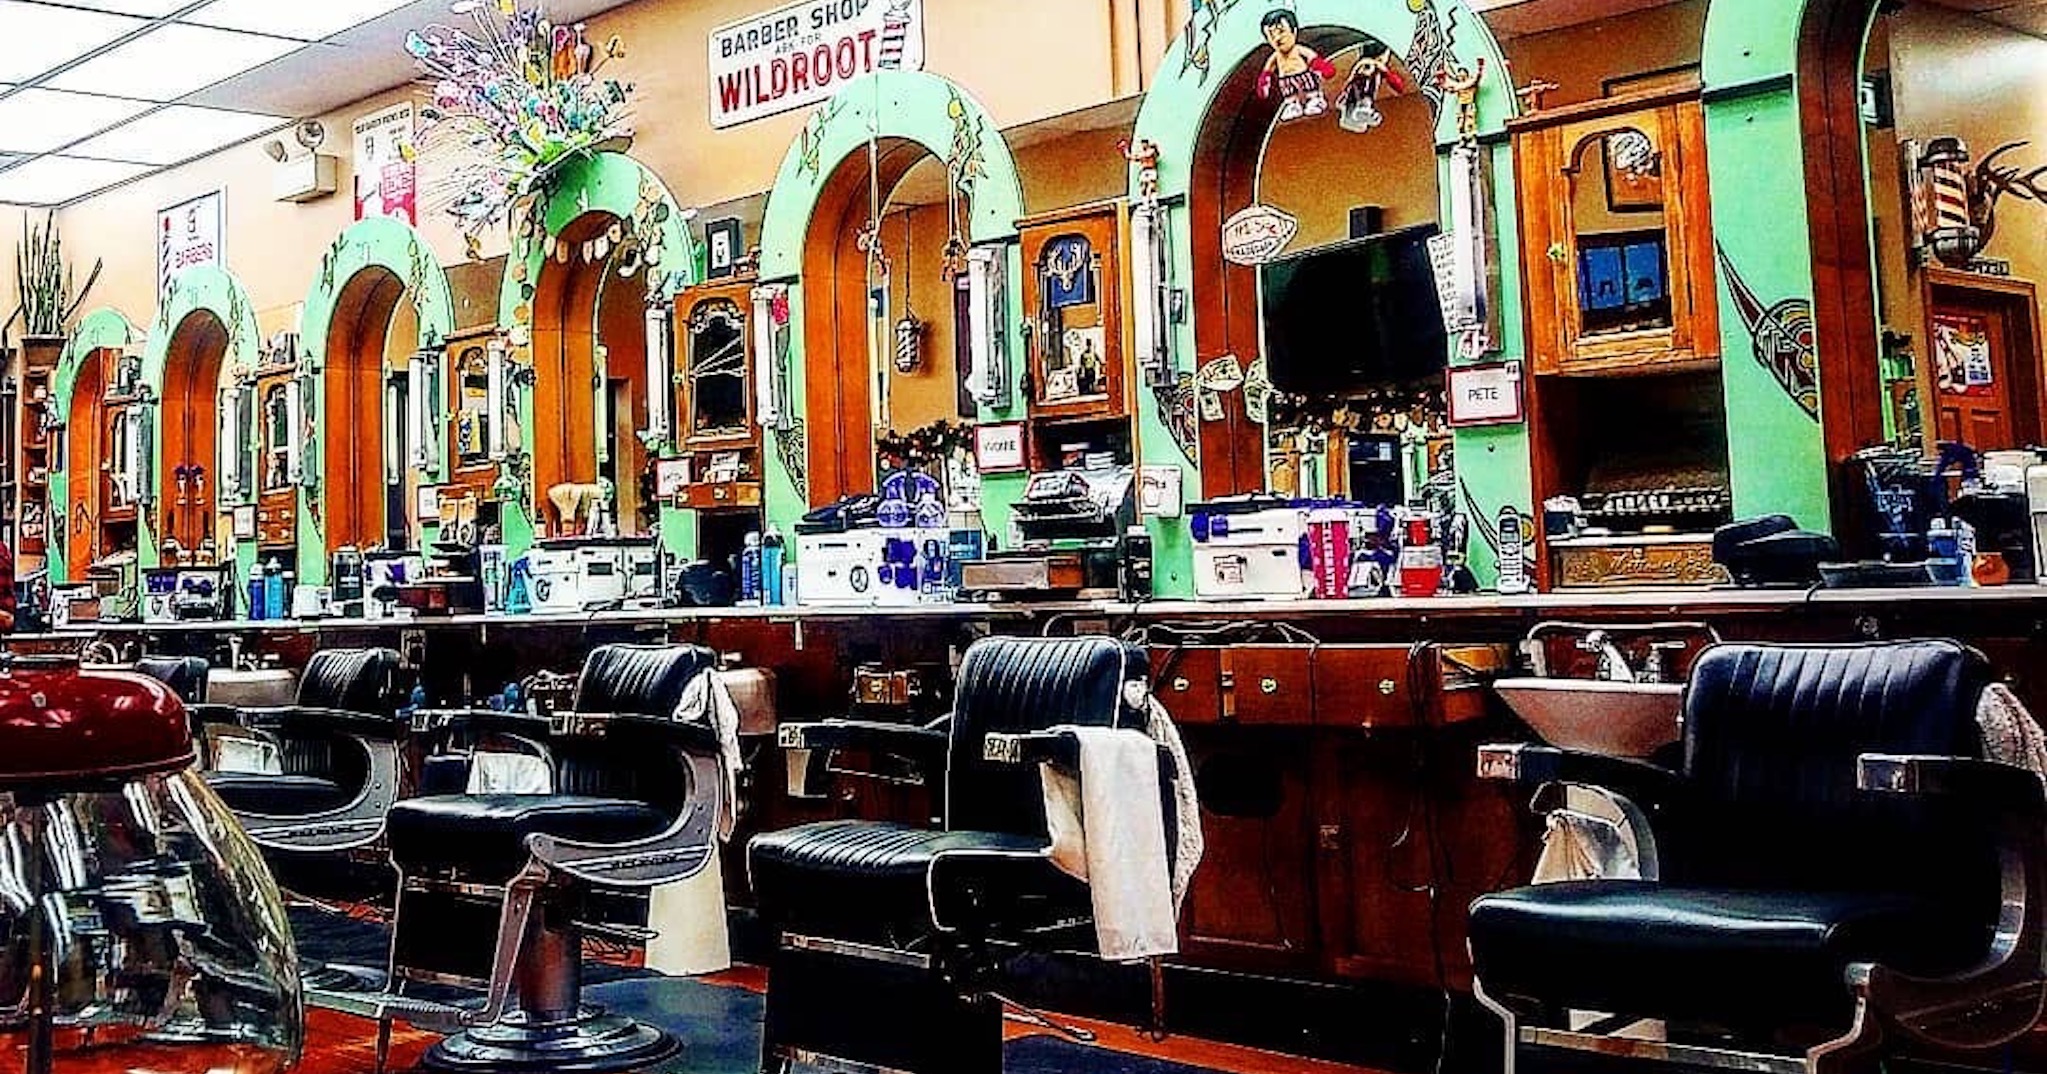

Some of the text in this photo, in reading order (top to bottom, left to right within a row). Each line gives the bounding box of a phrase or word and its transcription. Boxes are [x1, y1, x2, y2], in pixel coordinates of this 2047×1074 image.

[721, 0, 869, 58] BARBER SHOP
[801, 34, 821, 46] FOR
[718, 29, 876, 114] WILDROOT
[1468, 387, 1499, 402] PETE
